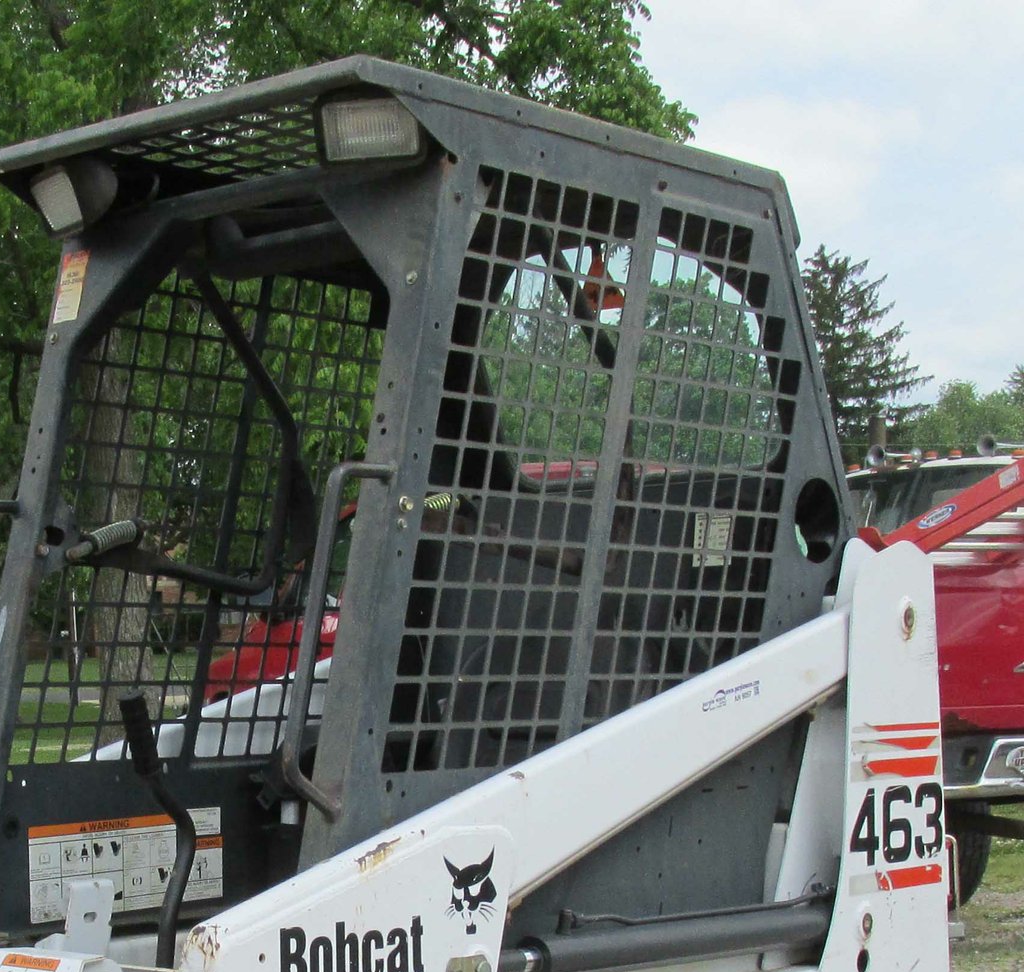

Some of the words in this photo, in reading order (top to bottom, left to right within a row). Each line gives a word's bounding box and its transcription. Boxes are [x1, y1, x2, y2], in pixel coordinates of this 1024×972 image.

[88, 819, 129, 832] WARNING
[850, 782, 942, 866] 463
[20, 956, 54, 969] WARNING
